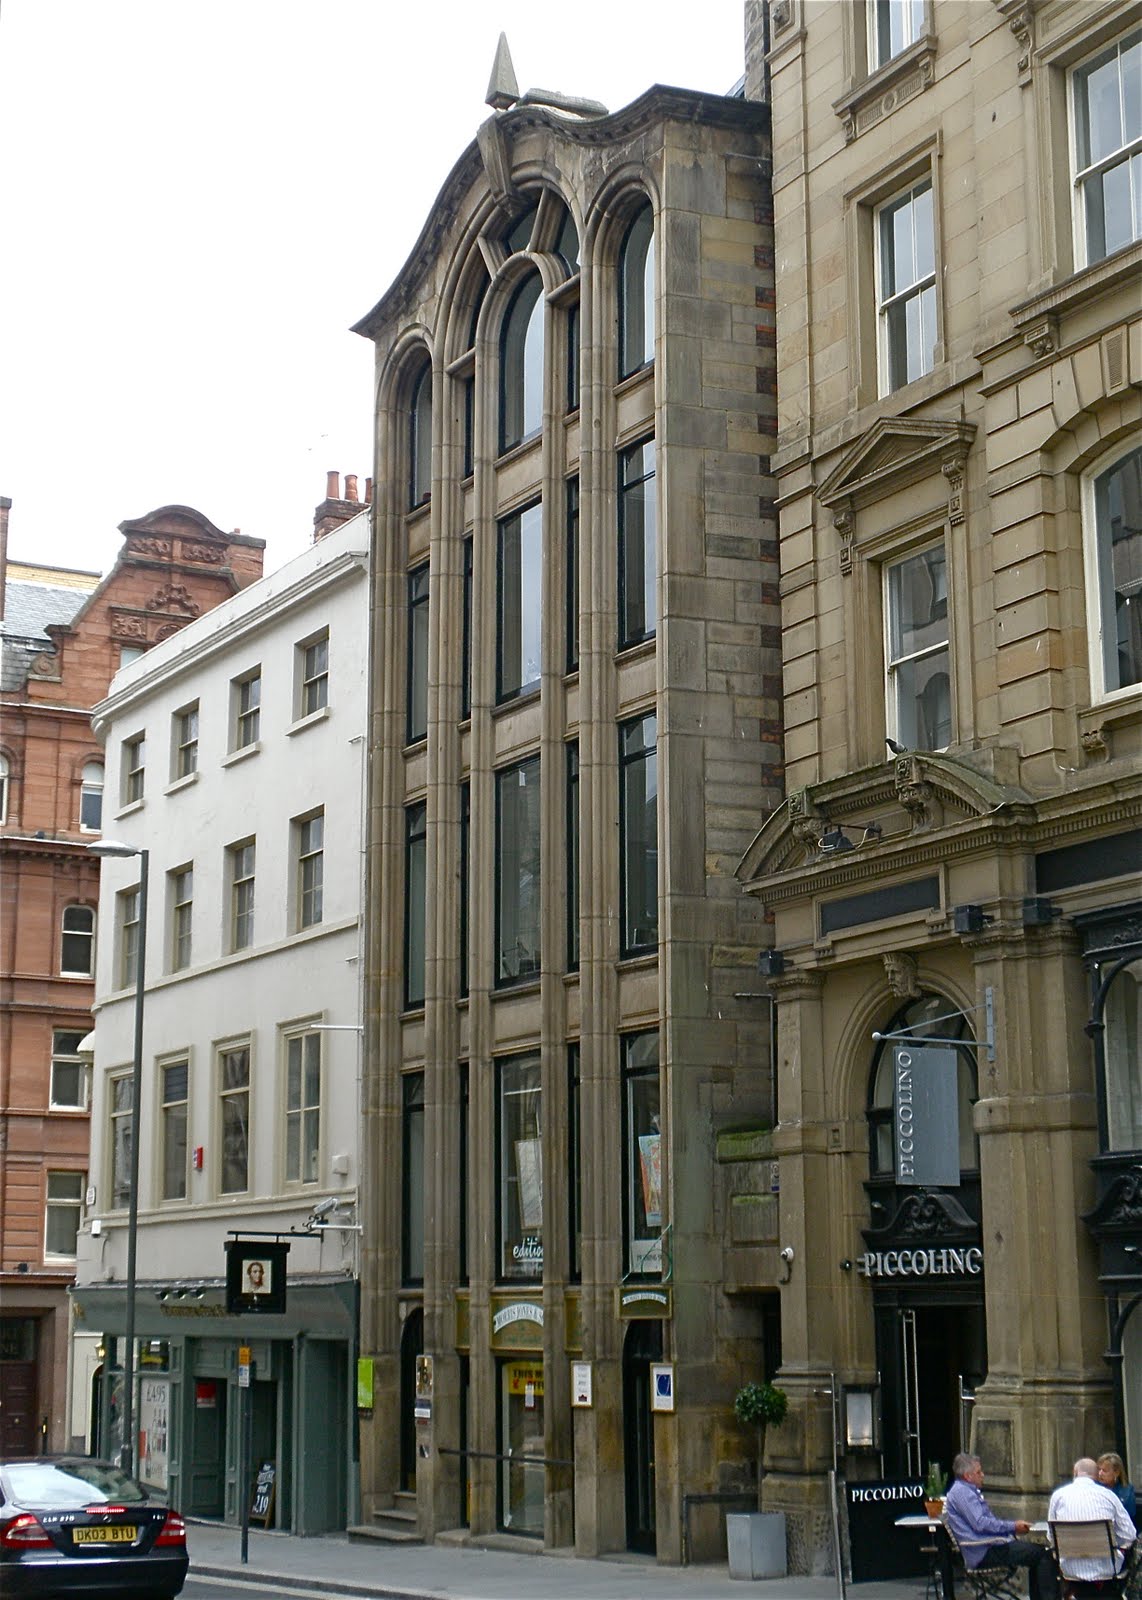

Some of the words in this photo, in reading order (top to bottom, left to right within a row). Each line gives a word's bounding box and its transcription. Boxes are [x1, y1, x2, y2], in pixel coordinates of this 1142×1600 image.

[898, 1051, 914, 1177] PICCOLINO
[863, 1247, 983, 1277] PICCOLINO
[851, 1485, 924, 1502] PICCOLINO
[76, 1530, 107, 1541] DK03
[111, 1528, 134, 1540] BTU
